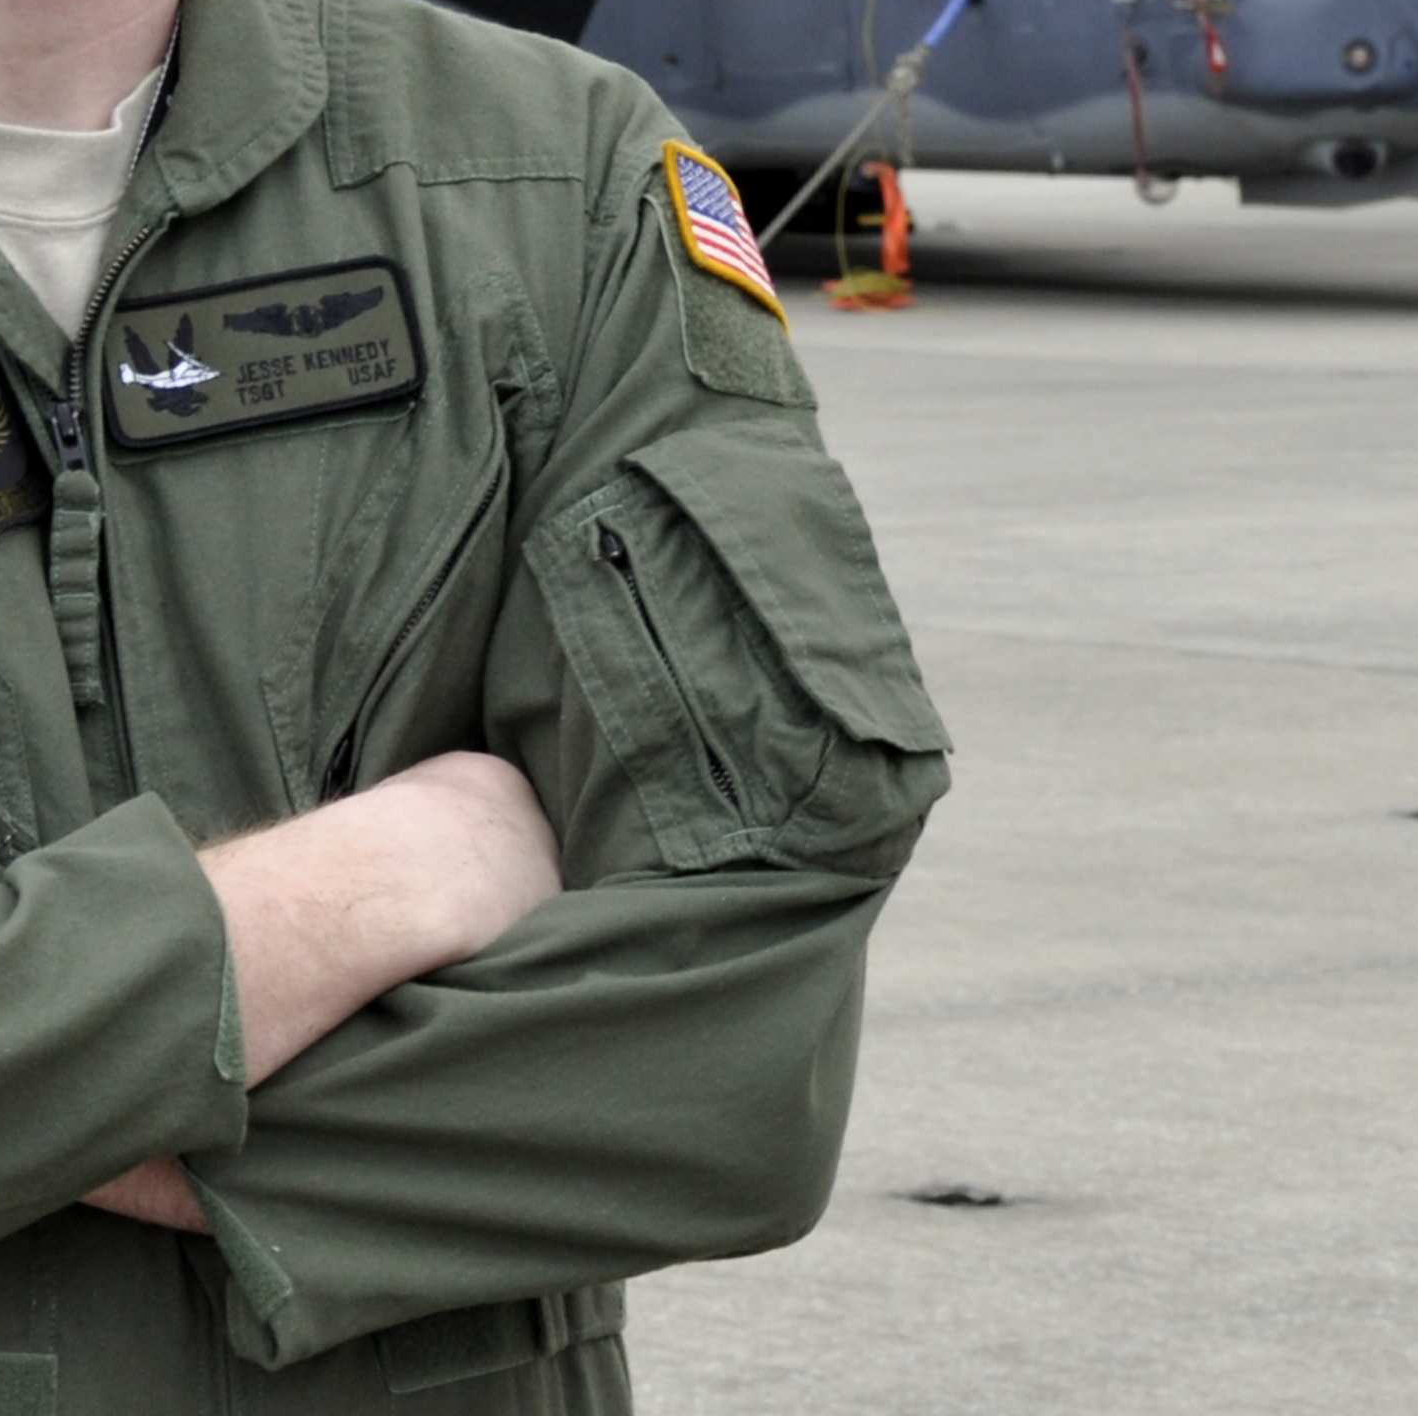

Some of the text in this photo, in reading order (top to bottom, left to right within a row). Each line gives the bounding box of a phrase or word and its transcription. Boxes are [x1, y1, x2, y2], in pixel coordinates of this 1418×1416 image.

[234, 358, 397, 406] TSGT USAF
[236, 338, 391, 384] JESSE KENNEDY
